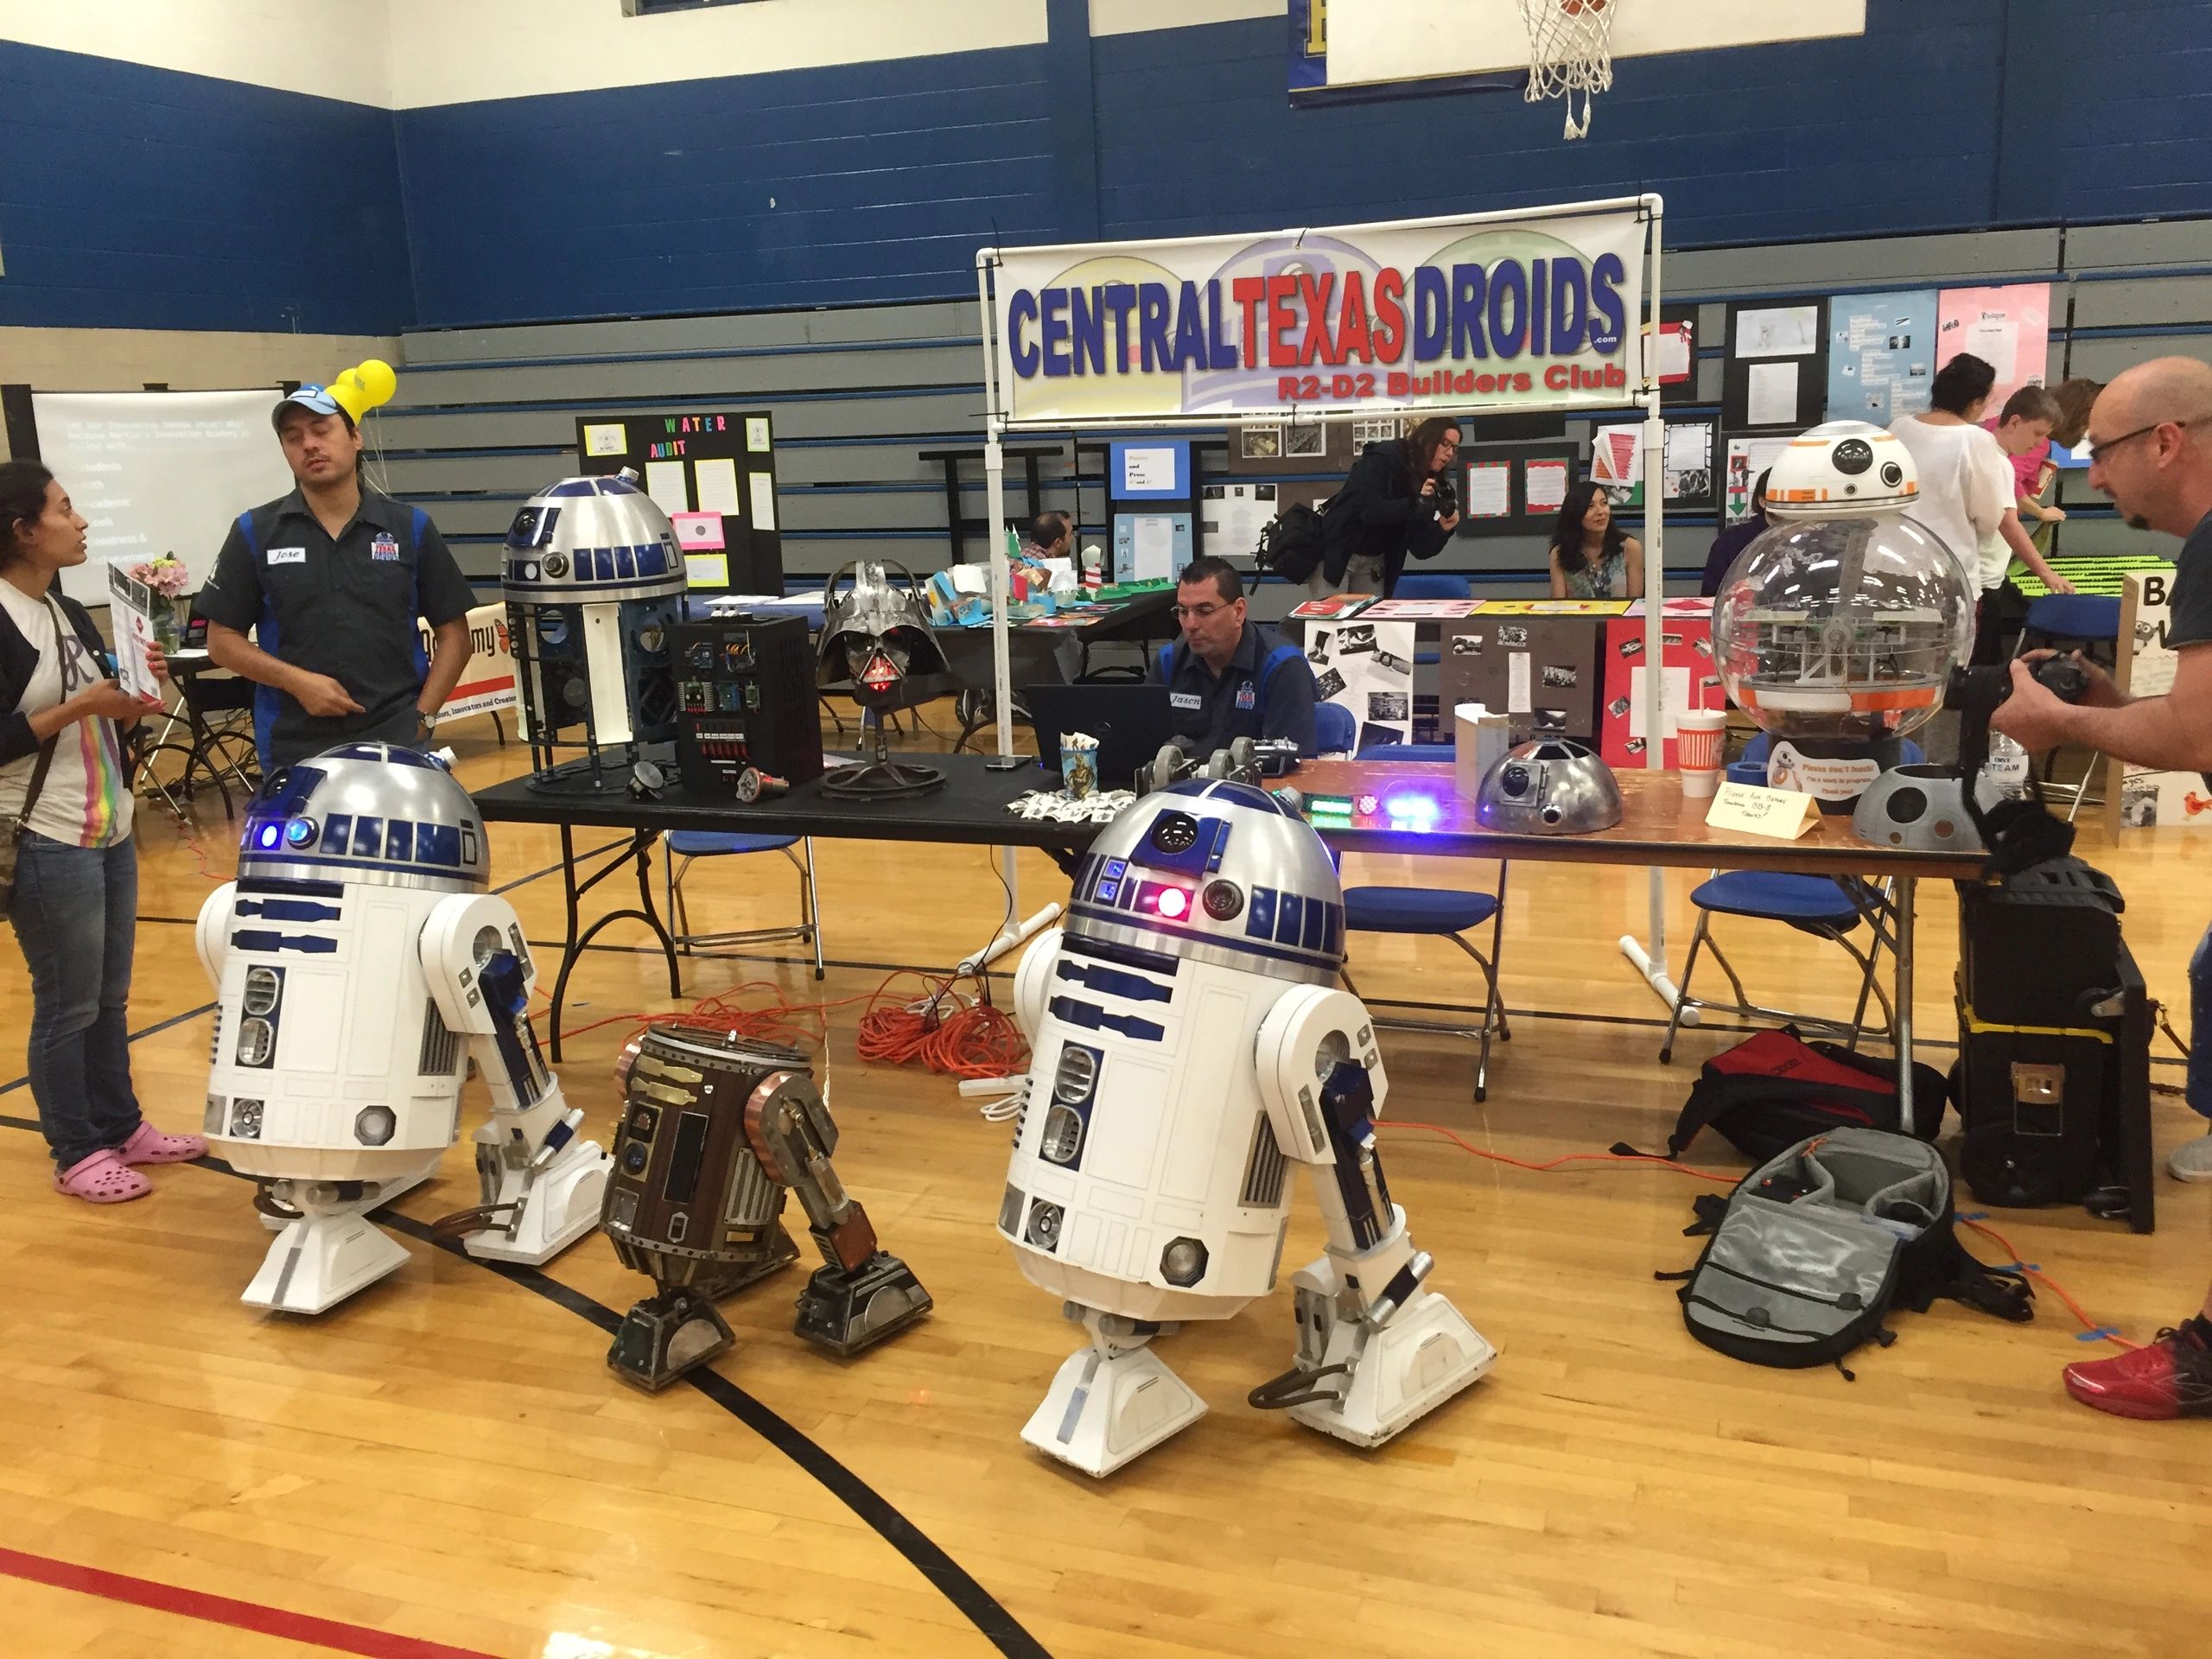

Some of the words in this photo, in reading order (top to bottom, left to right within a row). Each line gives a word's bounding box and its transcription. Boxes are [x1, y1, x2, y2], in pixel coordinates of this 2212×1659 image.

[1277, 373, 1376, 400] R2-D2
[1387, 369, 1532, 397] Builders
[1543, 363, 1626, 391] Club
[664, 416, 727, 433] WATER
[651, 440, 686, 458] AUDIT
